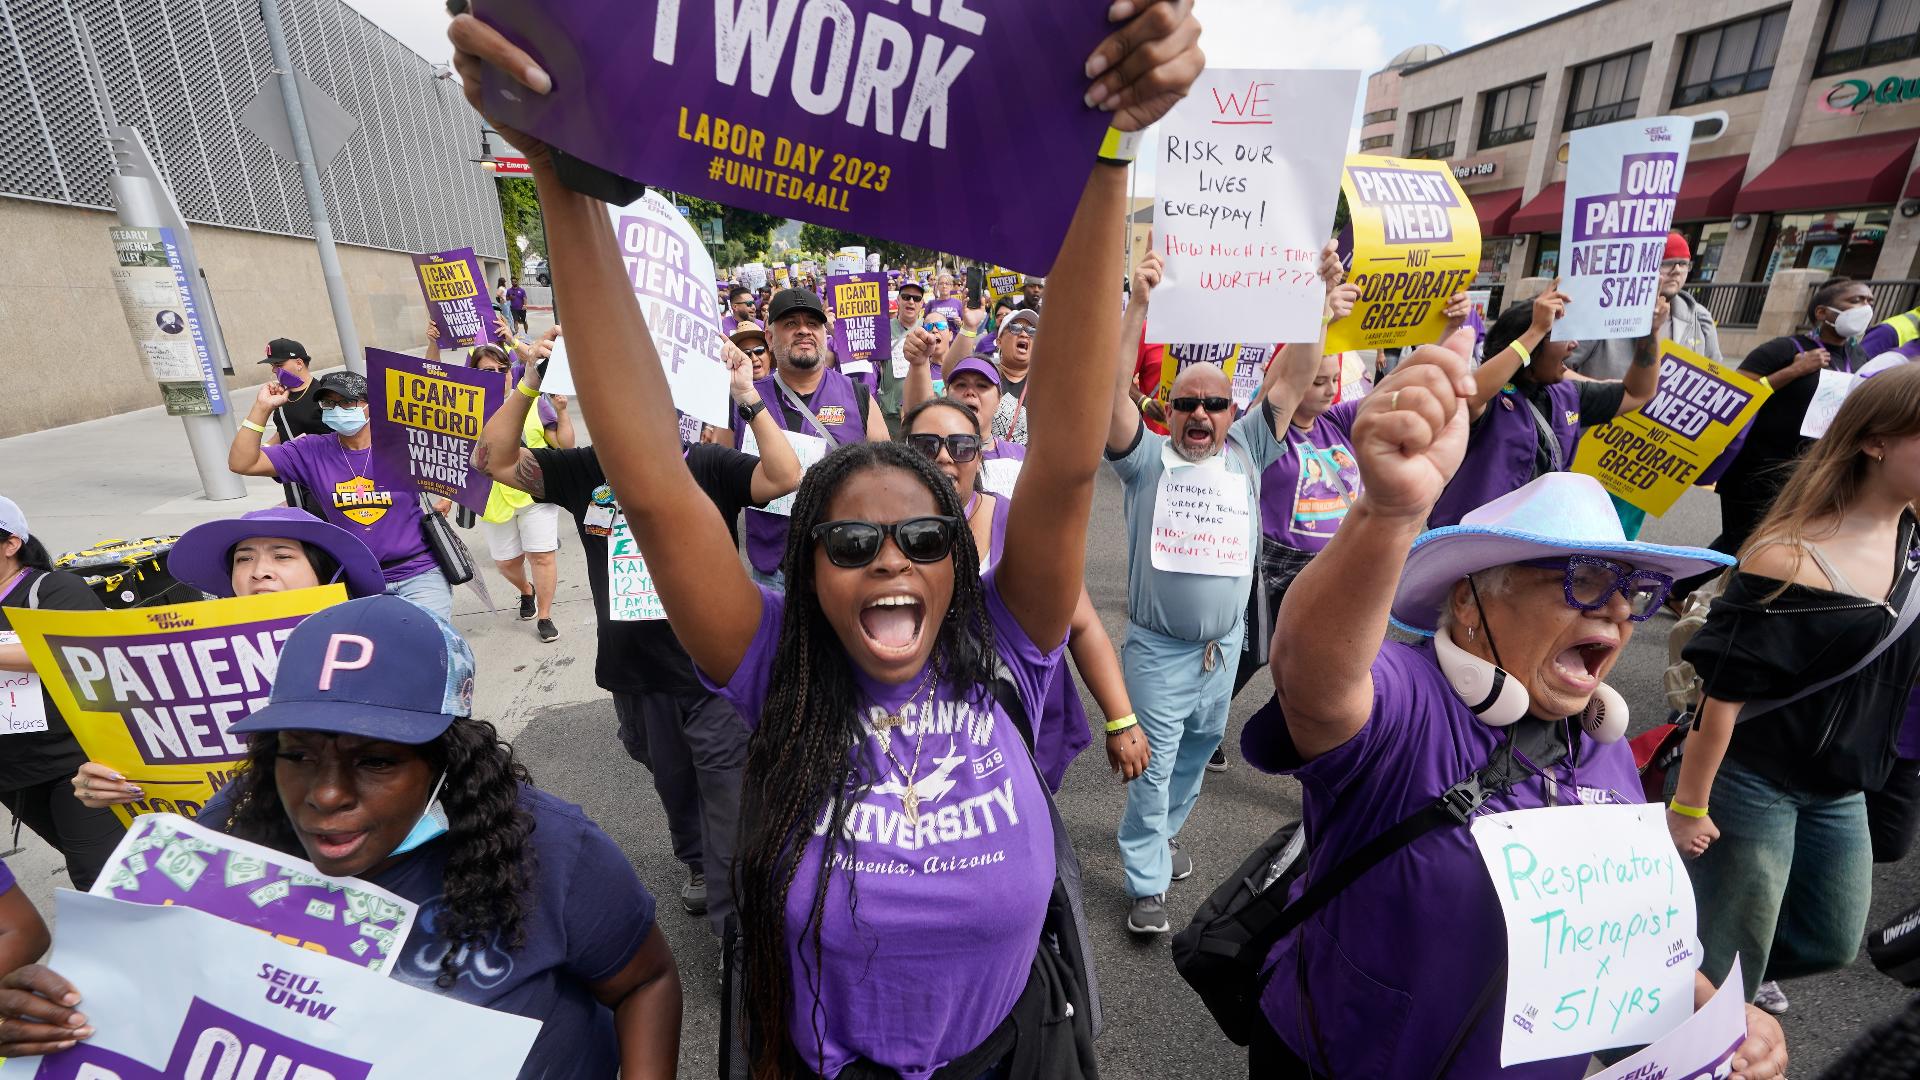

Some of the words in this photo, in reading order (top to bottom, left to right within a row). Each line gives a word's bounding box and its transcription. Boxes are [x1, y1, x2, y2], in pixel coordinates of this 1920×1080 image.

[714, 0, 975, 149] WORK
[1213, 81, 1275, 117] WE
[678, 106, 766, 161] LABOR
[774, 137, 825, 176] DAY
[829, 153, 891, 193] 2023
[1167, 135, 1223, 165] RISK
[1235, 144, 1274, 164] OUR
[708, 157, 850, 213] #UNITED4ALL
[1199, 169, 1247, 192] LIVES
[1353, 171, 1451, 202] PATIENT
[1626, 159, 1675, 196] OUR
[120, 230, 149, 240] EARLY
[1384, 205, 1449, 240] NEED
[624, 223, 684, 270] OUR
[1165, 234, 1203, 256] HOW
[1210, 244, 1252, 257] MUCH
[1406, 249, 1430, 268] NOT
[1570, 243, 1635, 277] NEED
[430, 263, 466, 282] CAN'T
[622, 255, 714, 319] TIENTS
[1354, 269, 1470, 303] CORPORATE
[428, 280, 474, 299] AFFORD
[847, 284, 876, 300] CAN'T
[1599, 276, 1655, 308] STAFF
[438, 301, 452, 314] TO
[452, 298, 476, 313] LIVE
[442, 310, 480, 326] WHERE
[838, 300, 878, 318] AFFORD
[1360, 301, 1431, 330] GREED
[165, 243, 185, 282] ANGELS
[179, 285, 194, 314] WALK
[188, 318, 203, 342] EAST
[197, 345, 220, 401] HOLLYWOOD
[447, 326, 454, 338] I
[650, 302, 721, 363] MORE
[845, 318, 856, 330] TO
[856, 317, 875, 329] LIVE
[846, 328, 875, 340] WHERE
[852, 338, 876, 352] WORK
[398, 375, 405, 397] I
[411, 378, 479, 412] CAN'T
[1659, 358, 1747, 420] PATIENT
[392, 399, 478, 437] AFFORD
[1644, 390, 1709, 436] NEED
[406, 427, 428, 446] TO
[432, 434, 470, 455] LIVE
[1646, 427, 1671, 445] NOT
[407, 443, 469, 471] WHERE
[1592, 421, 1698, 485] CORPORATE
[410, 460, 416, 476] I
[418, 461, 468, 489] WORK
[1597, 448, 1659, 491] GREED
[332, 491, 393, 508] LEADER
[318, 633, 374, 691] P
[923, 850, 1006, 874] Arizona
[1502, 843, 1676, 904] Respiratory
[1530, 905, 1679, 969] Therapist
[1672, 938, 1684, 953] AM
[1665, 950, 1693, 968] COOL
[257, 962, 323, 994] SEIU-
[265, 987, 338, 1021] UHW
[1528, 1005, 1539, 1019] AM
[1552, 986, 1599, 1031] 51
[1512, 1014, 1535, 1034] COOL
